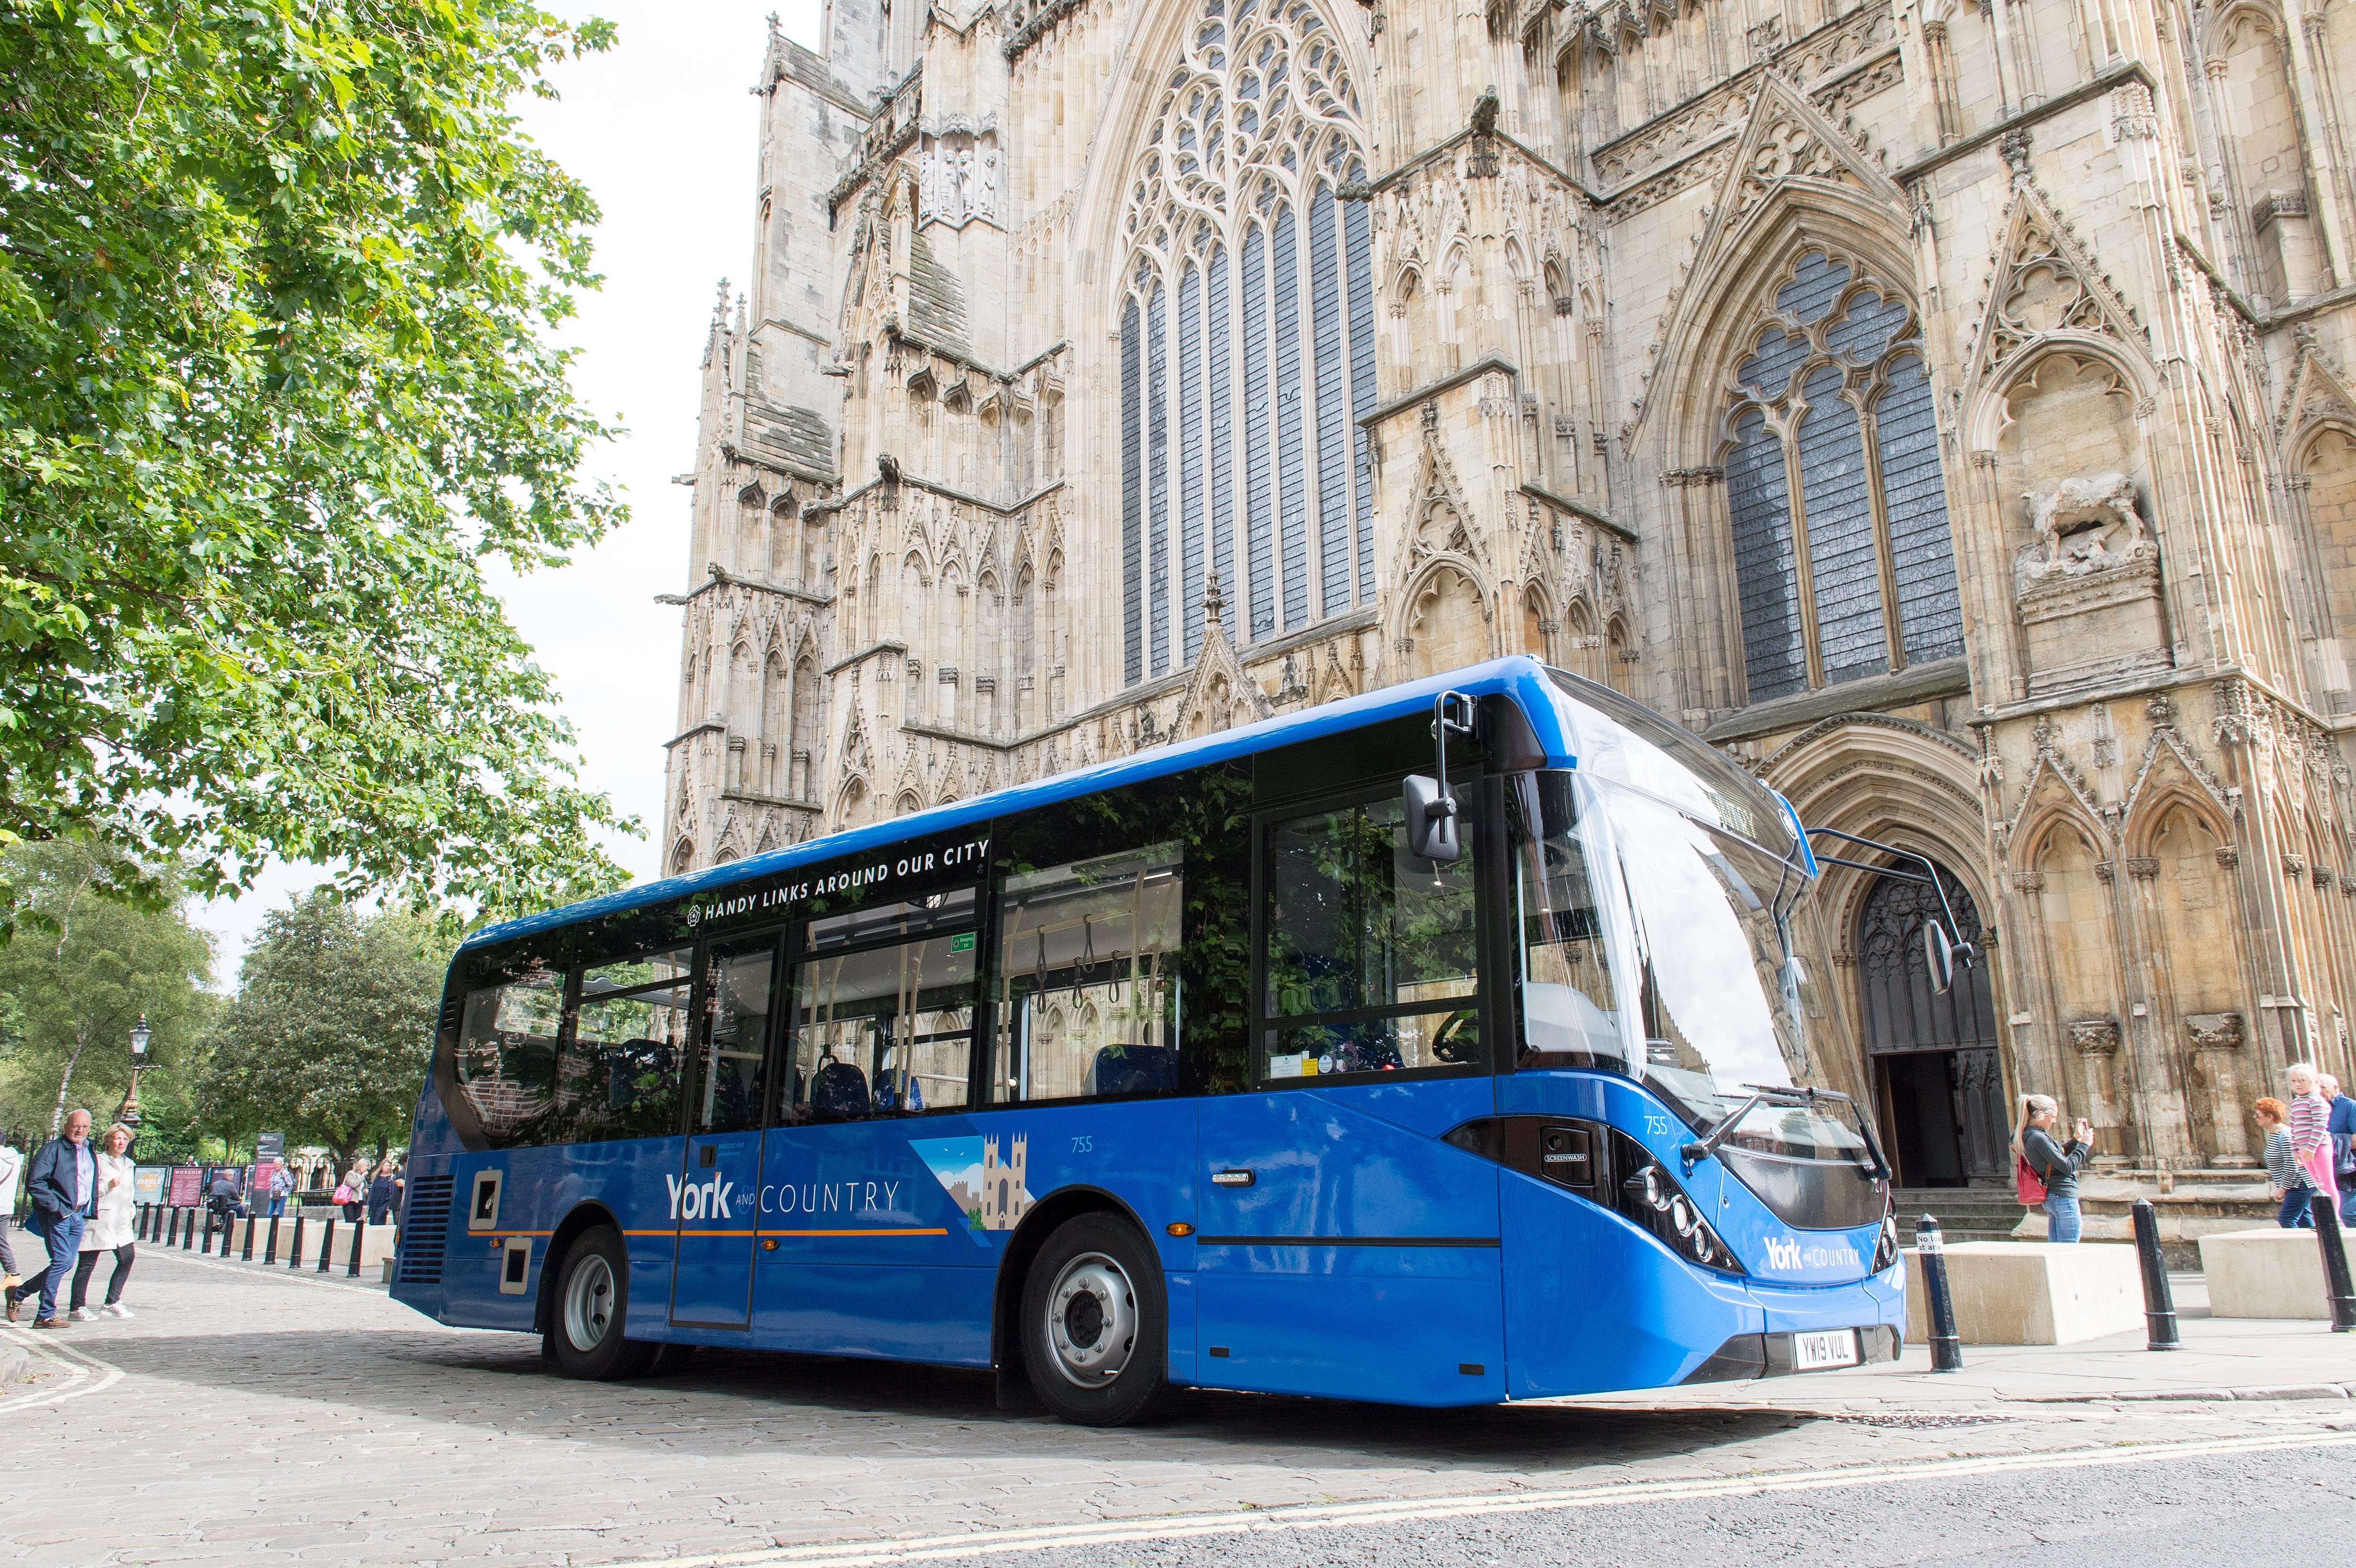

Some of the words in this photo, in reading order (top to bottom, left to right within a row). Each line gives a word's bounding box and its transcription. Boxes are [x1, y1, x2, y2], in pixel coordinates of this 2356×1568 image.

[705, 894, 756, 920] HANDY
[763, 882, 808, 907] LINKS
[815, 864, 888, 895] AROUND
[897, 853, 934, 876] OUR
[944, 839, 989, 865] CITY
[1644, 1115, 1667, 1134] 755
[1072, 1136, 1092, 1153] 755
[666, 1171, 734, 1220] York
[735, 1193, 755, 1205] AND
[761, 1181, 898, 1213] COUNTRY
[1763, 1237, 1803, 1270] York
[1812, 1249, 1858, 1266] COUNTRY
[1803, 1336, 1826, 1362] YW19
[1828, 1335, 1848, 1360] VUL
